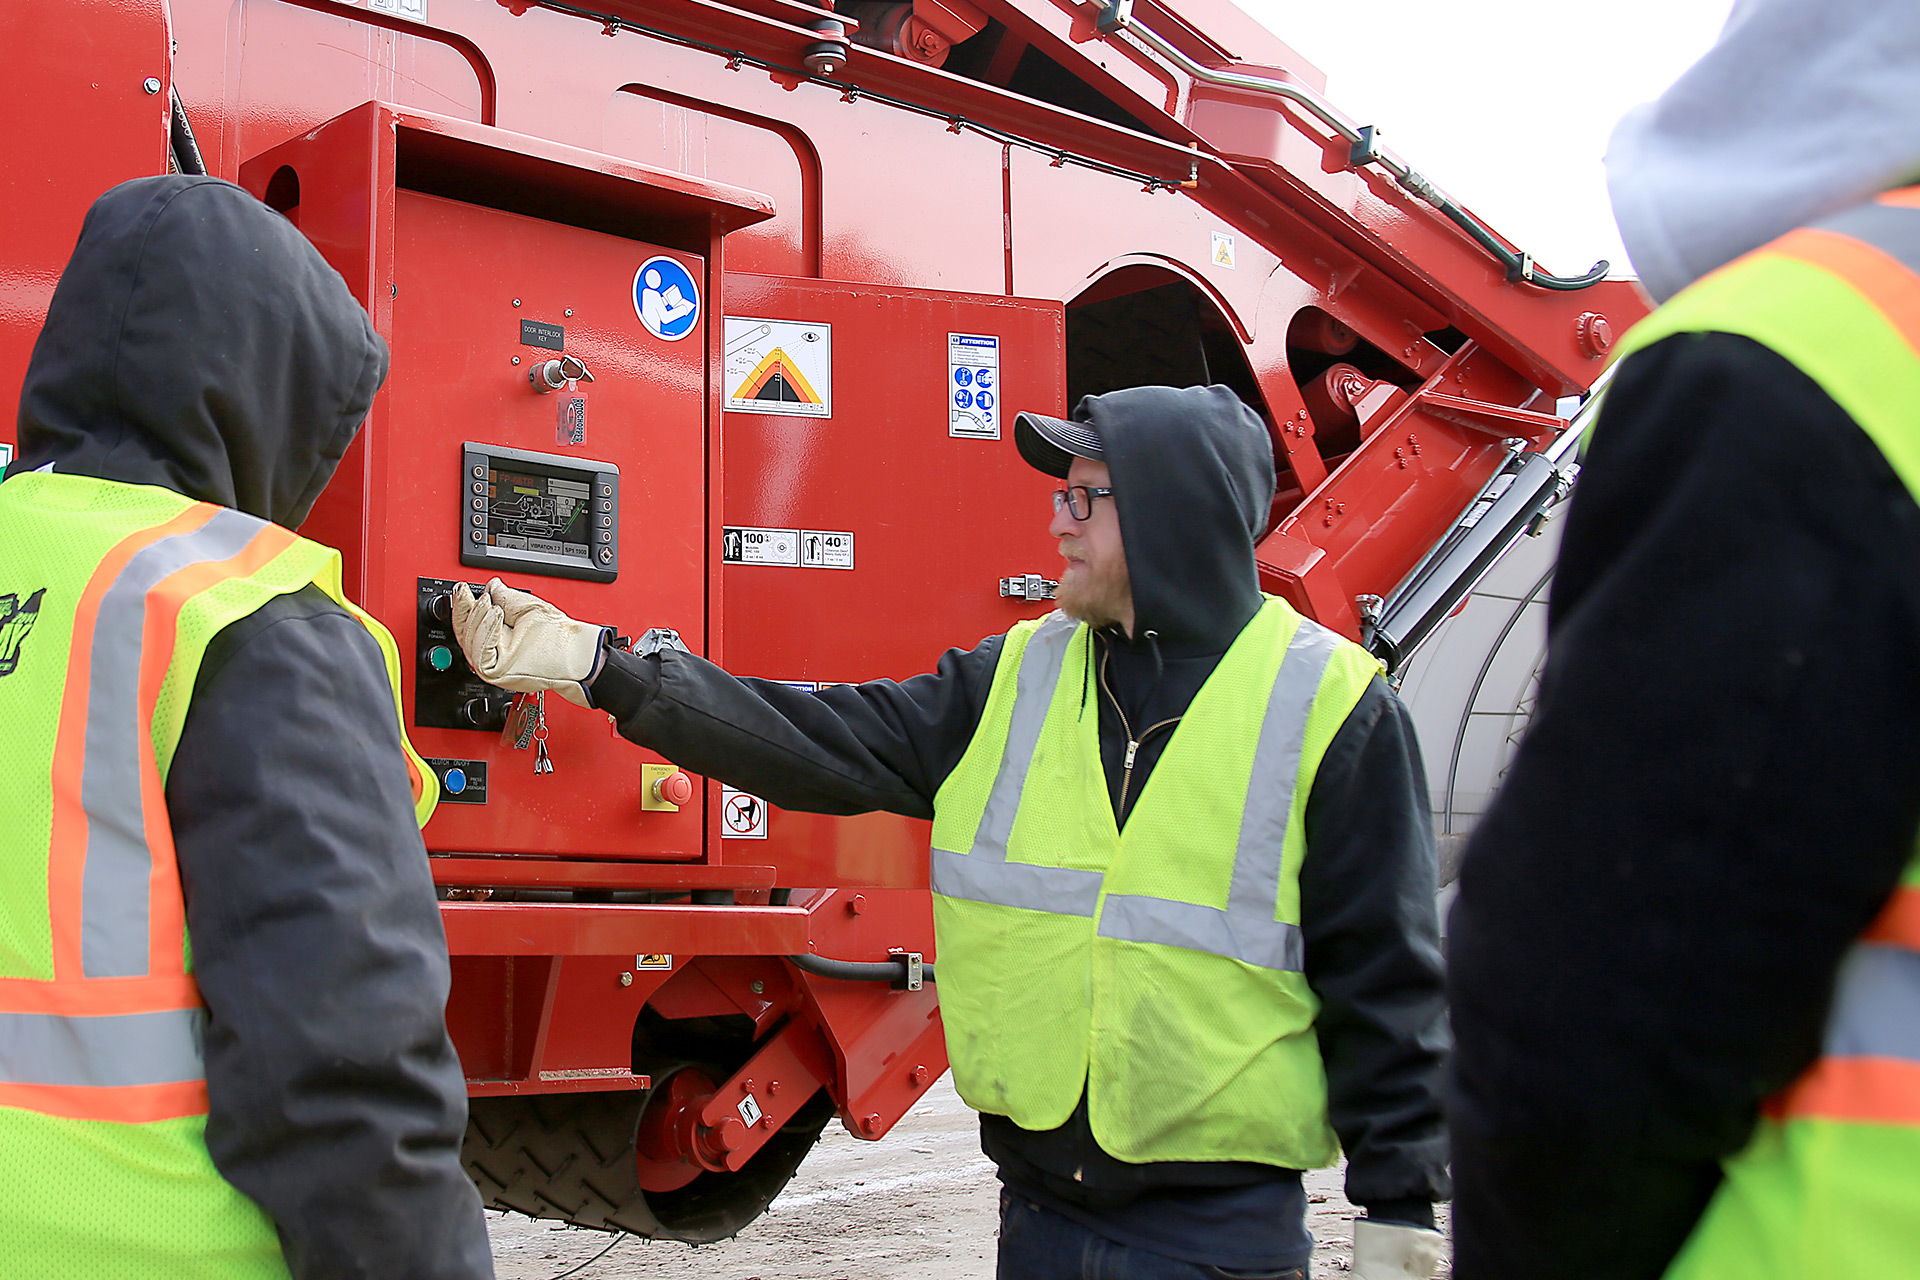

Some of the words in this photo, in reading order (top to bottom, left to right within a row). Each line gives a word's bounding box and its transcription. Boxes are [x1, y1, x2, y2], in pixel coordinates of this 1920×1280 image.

[524, 325, 537, 334] DOOR
[537, 328, 562, 339] INTERLOCK
[961, 338, 995, 346] ATTENTION
[571, 398, 585, 445] ROTOCHOPPER
[743, 533, 764, 544] 100
[825, 537, 842, 548] 40
[530, 543, 554, 551] VIBRATION
